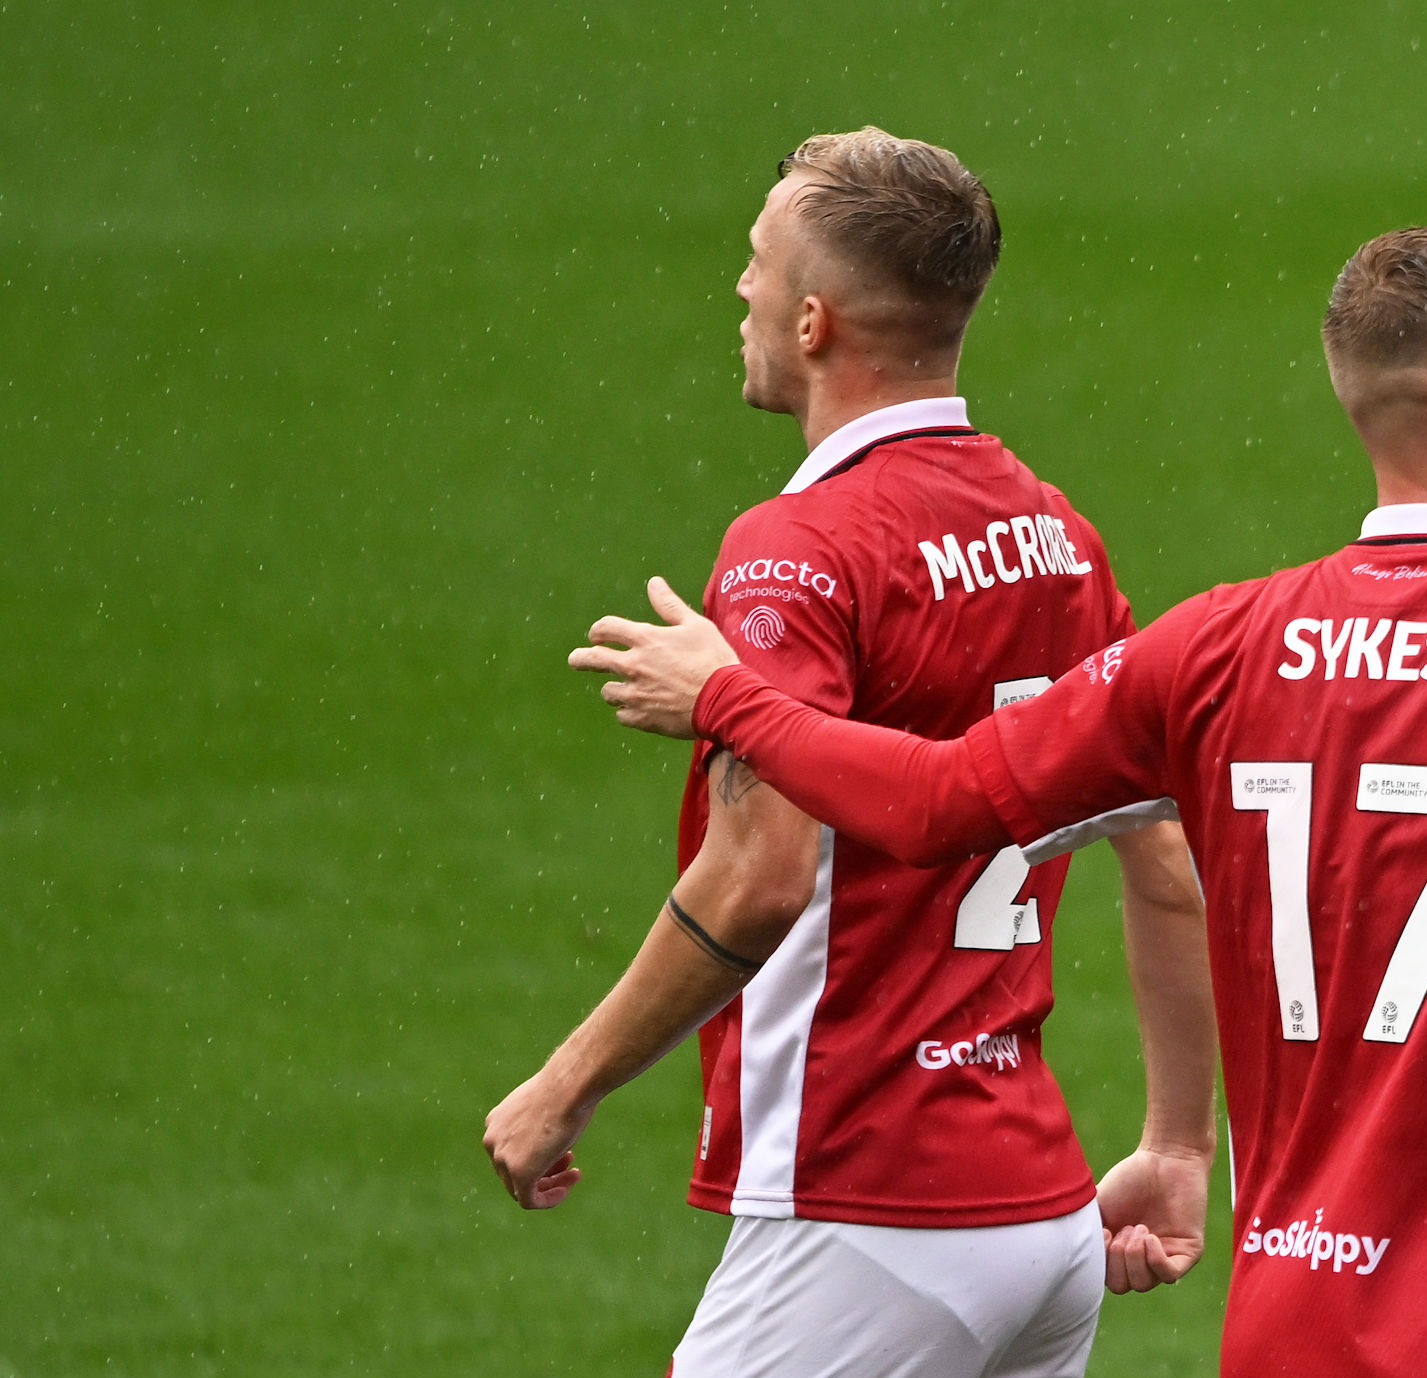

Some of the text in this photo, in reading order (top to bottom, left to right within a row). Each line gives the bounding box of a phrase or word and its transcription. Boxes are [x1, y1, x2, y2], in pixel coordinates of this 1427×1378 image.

[720, 559, 837, 599] exacta
[729, 586, 809, 605] technologies
[1256, 778, 1268, 786] EFL
[1396, 780, 1405, 788] IN
[1407, 781, 1420, 789] THE
[1256, 786, 1296, 794] COMMUNITY
[1292, 1024, 1305, 1033] EFL
[1382, 1025, 1396, 1034] EFL
